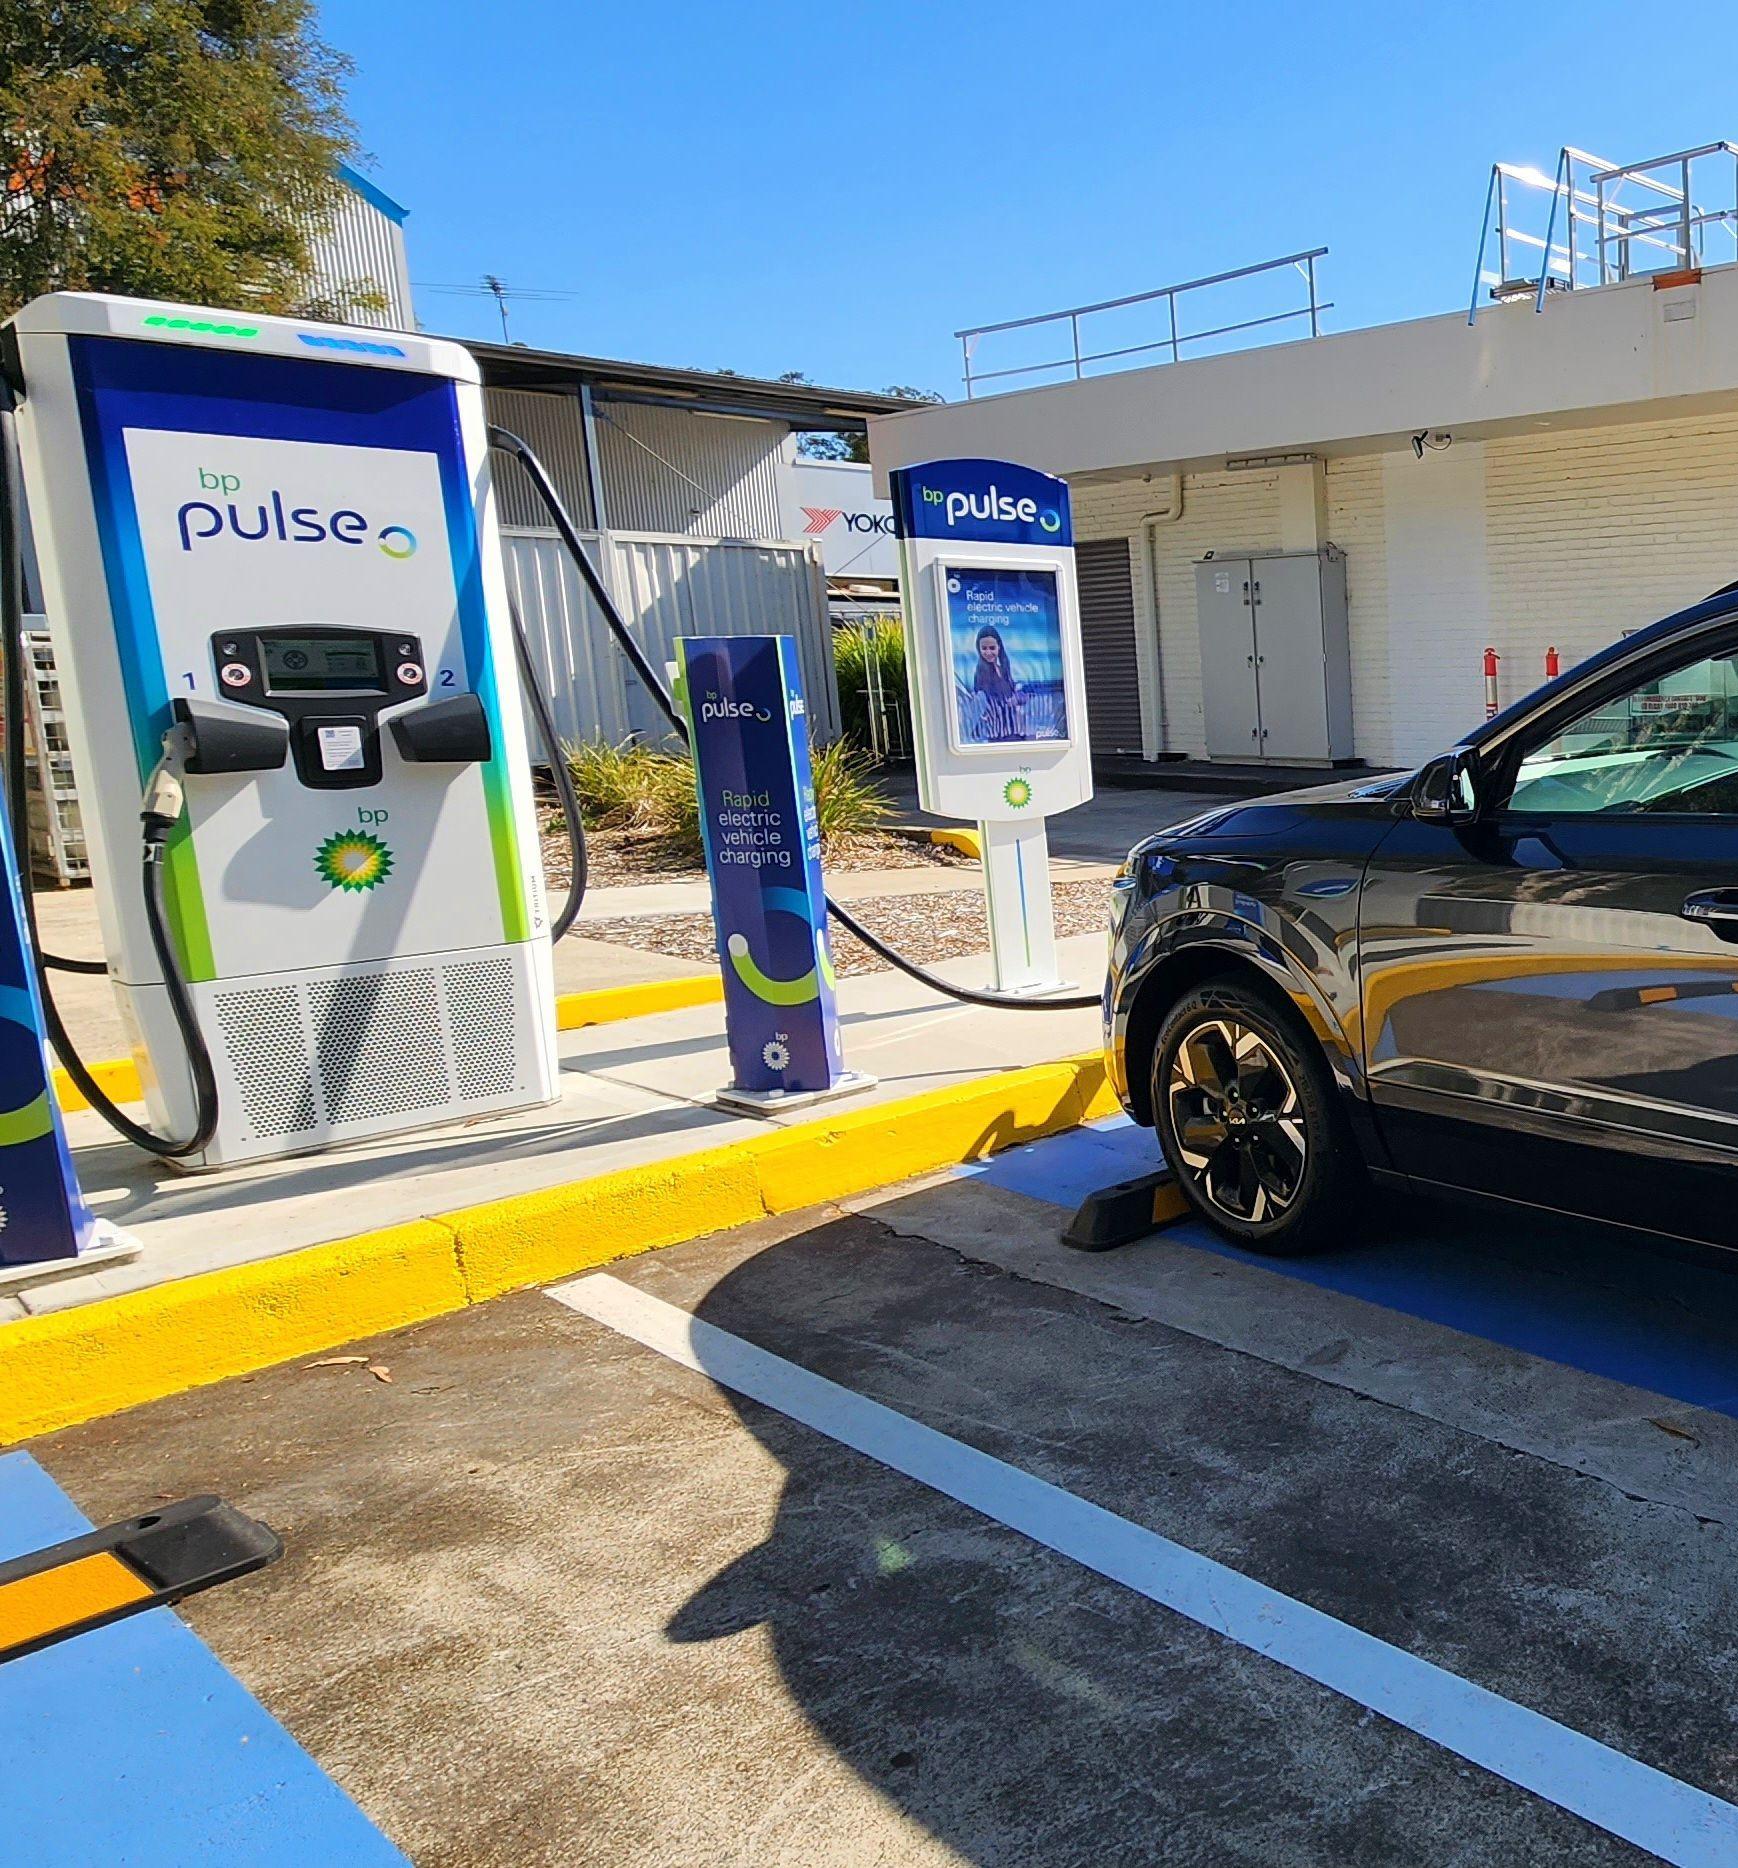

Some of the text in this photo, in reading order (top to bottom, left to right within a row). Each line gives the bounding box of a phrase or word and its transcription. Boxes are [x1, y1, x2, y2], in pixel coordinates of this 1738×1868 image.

[198, 466, 241, 496] bp
[922, 485, 1037, 526] bp pulse
[177, 490, 369, 551] pulse
[965, 590, 994, 602] Rapid
[967, 602, 1039, 613] electric vehicle
[968, 614, 1010, 626] charging
[182, 671, 196, 691] 1
[439, 669, 456, 687] 2
[706, 690, 717, 701] bp
[701, 697, 754, 723] pulse
[1018, 765, 1032, 775] bp
[722, 790, 770, 810] Rapid
[357, 806, 389, 827] bp
[719, 810, 781, 827] electric
[721, 829, 781, 846] vehicle
[719, 848, 791, 869] charging
[775, 1031, 789, 1042] bp
